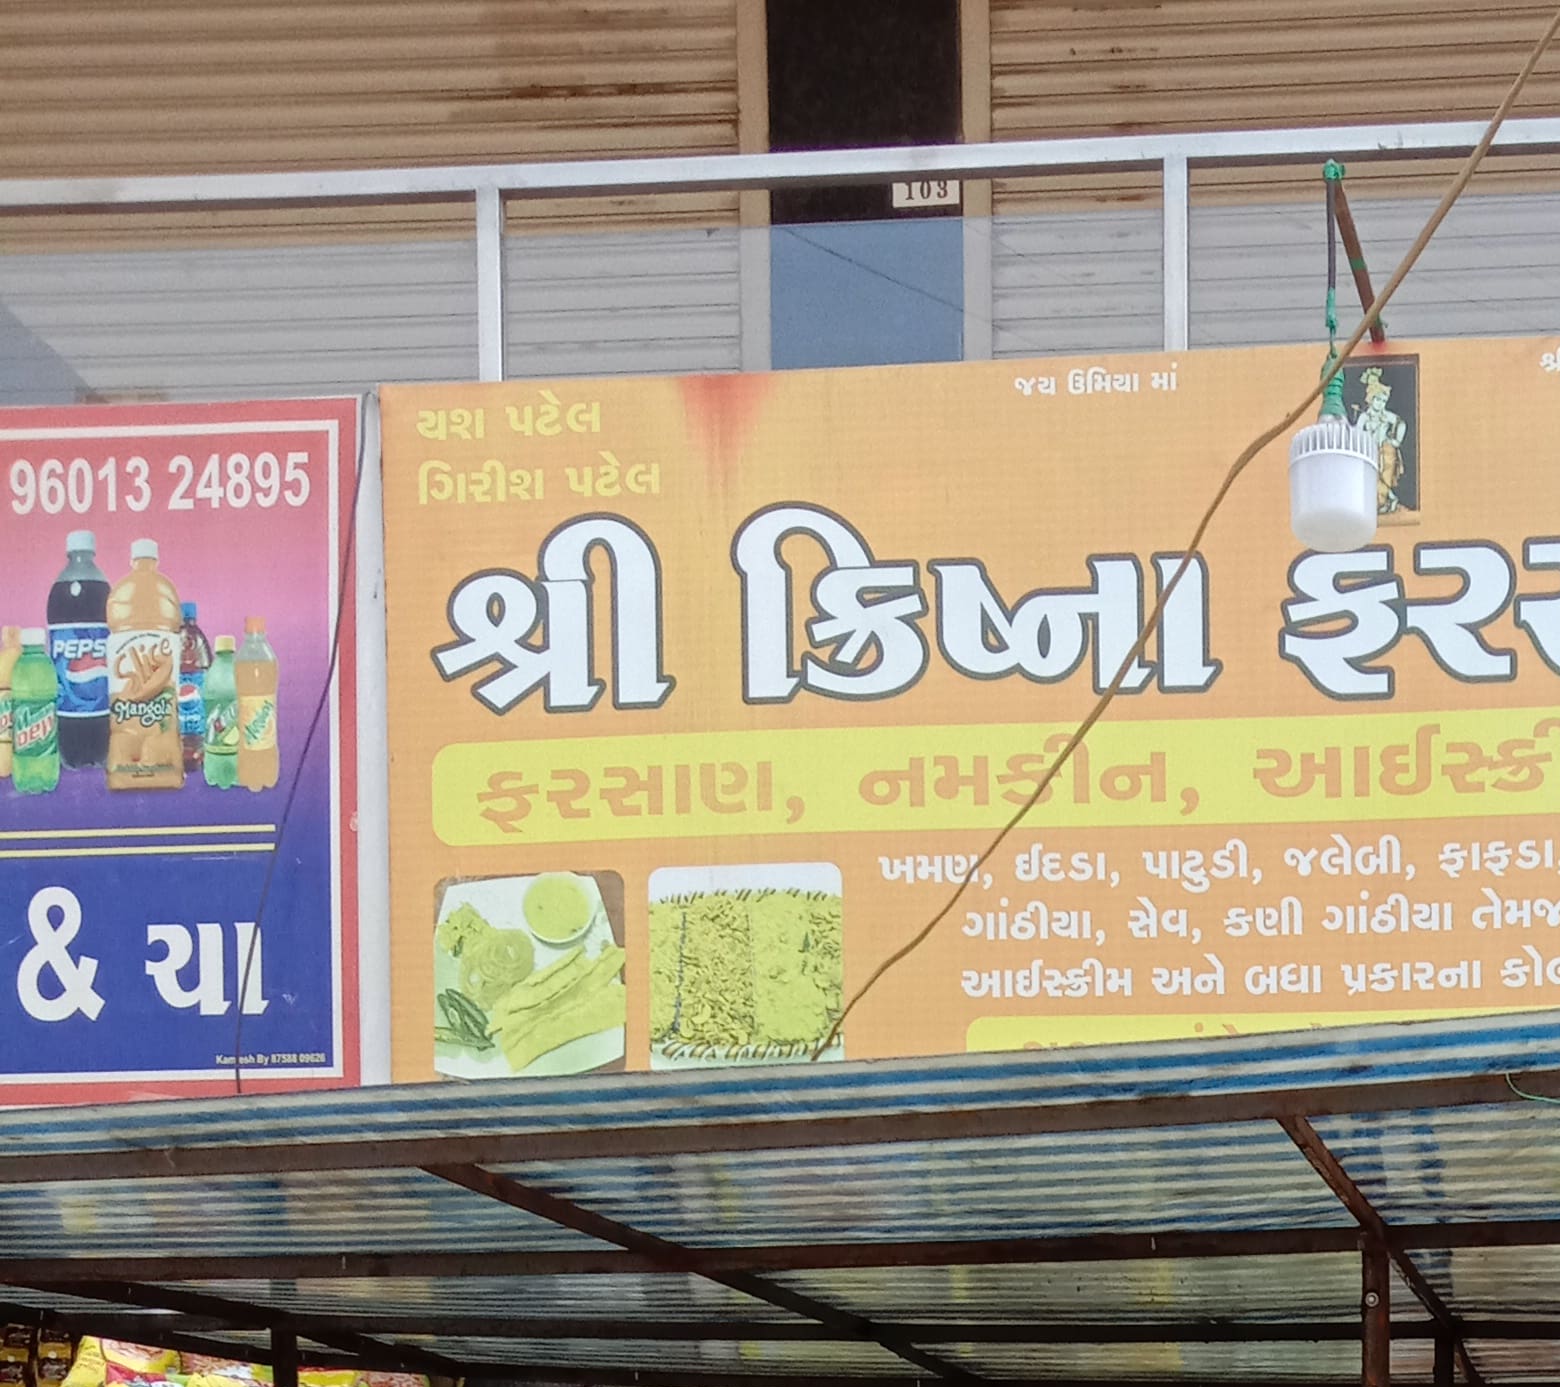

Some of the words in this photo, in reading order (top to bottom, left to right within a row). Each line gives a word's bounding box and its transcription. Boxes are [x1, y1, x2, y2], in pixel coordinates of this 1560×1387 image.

[905, 180, 948, 200] 103
[1014, 376, 1056, 398] જય
[416, 406, 485, 441] યશ
[505, 389, 601, 437] પટેલ
[9, 456, 151, 514] 96013
[168, 452, 310, 510] 24895
[417, 459, 544, 505] ગિરીશ
[565, 450, 661, 499] પટેલ
[431, 511, 676, 716] શ્રી
[476, 760, 805, 834] ફરસાણ,
[858, 733, 1201, 815] નમકીન,
[1127, 897, 1202, 944] સેવ,
[17, 886, 106, 1022] &
[145, 922, 270, 1016] ચા
[1152, 953, 1225, 996] અને
[1245, 961, 1322, 994] બધા
[1341, 958, 1482, 996] પ્રકારના
